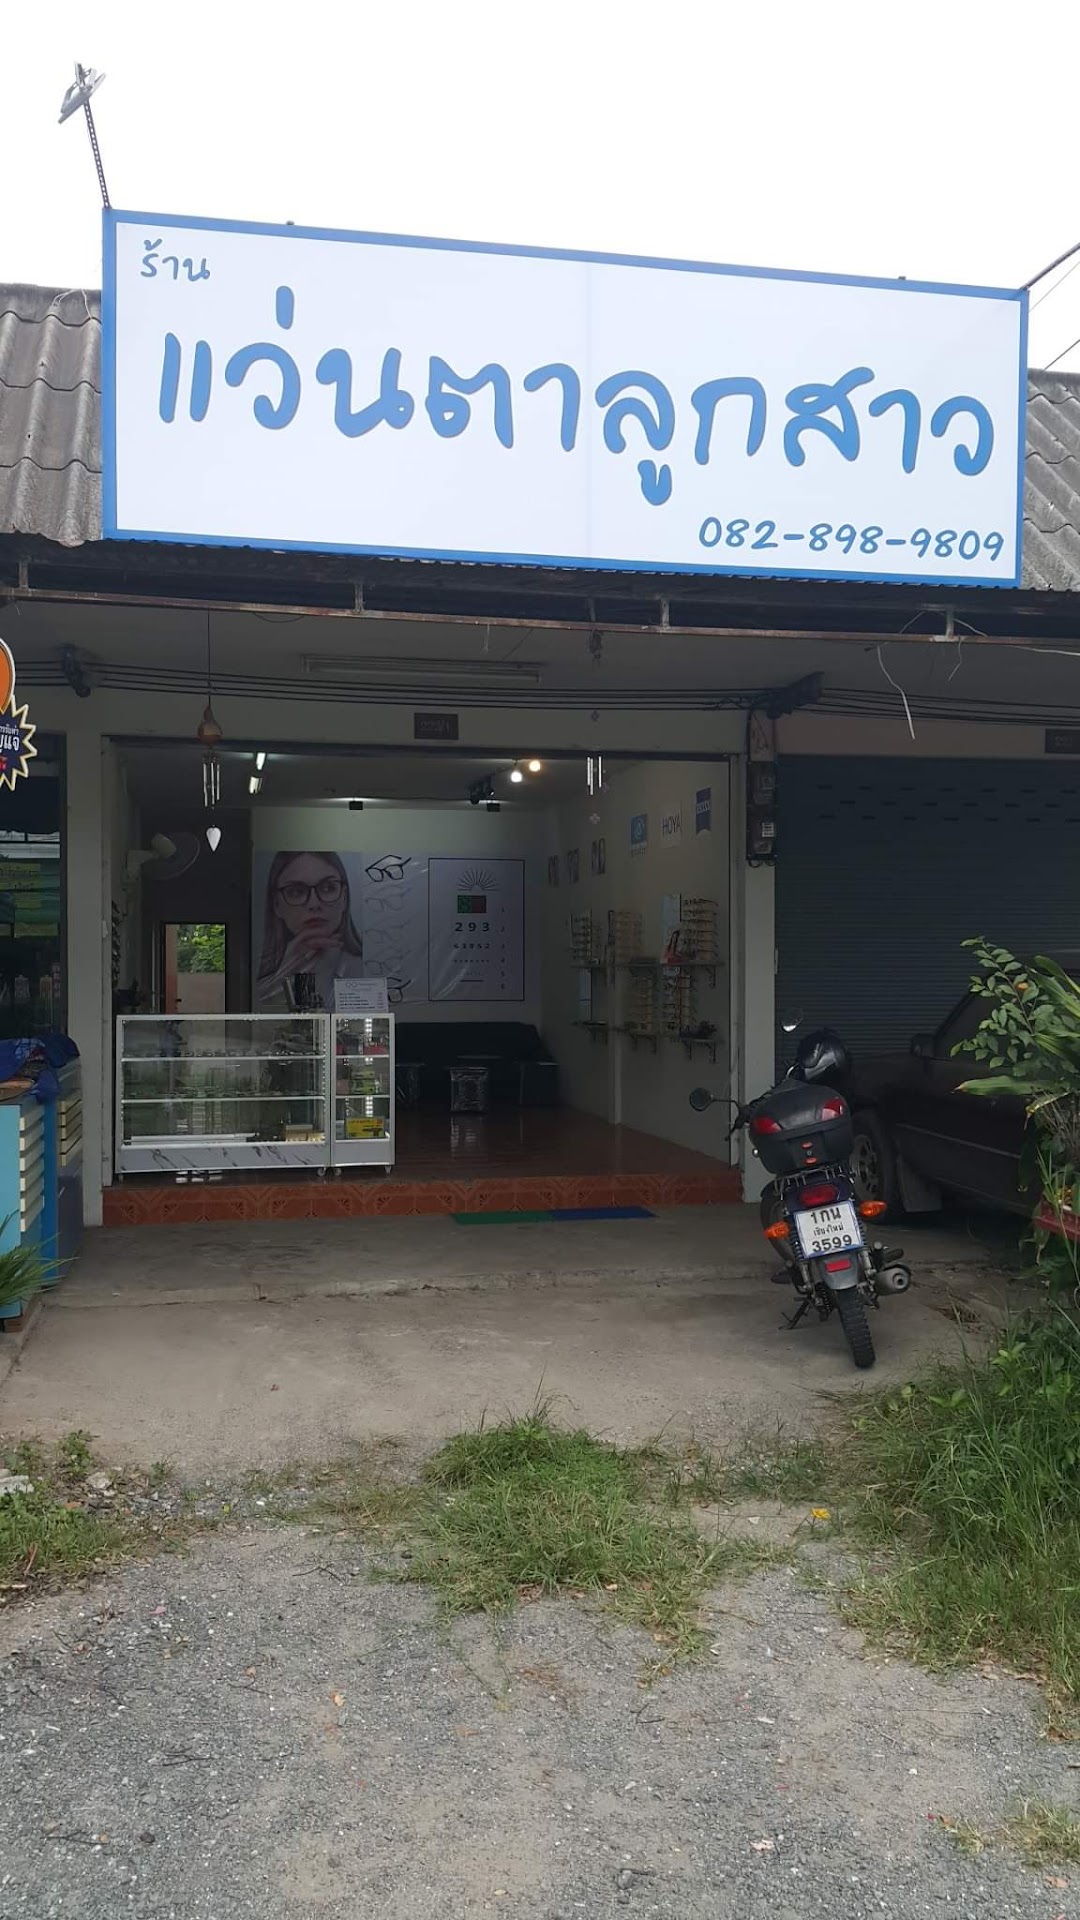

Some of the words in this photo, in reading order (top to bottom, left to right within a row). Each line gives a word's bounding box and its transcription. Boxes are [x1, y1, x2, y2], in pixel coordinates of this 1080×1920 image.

[141, 238, 210, 281] ร้าน
[159, 285, 995, 505] แว่นตาลูกสาว
[698, 516, 1004, 562] 082-898-9809
[662, 812, 681, 837] HOYA
[810, 1207, 842, 1223] 1กน
[814, 1223, 844, 1236] เชียงใหม่
[812, 1235, 852, 1252] 3599
